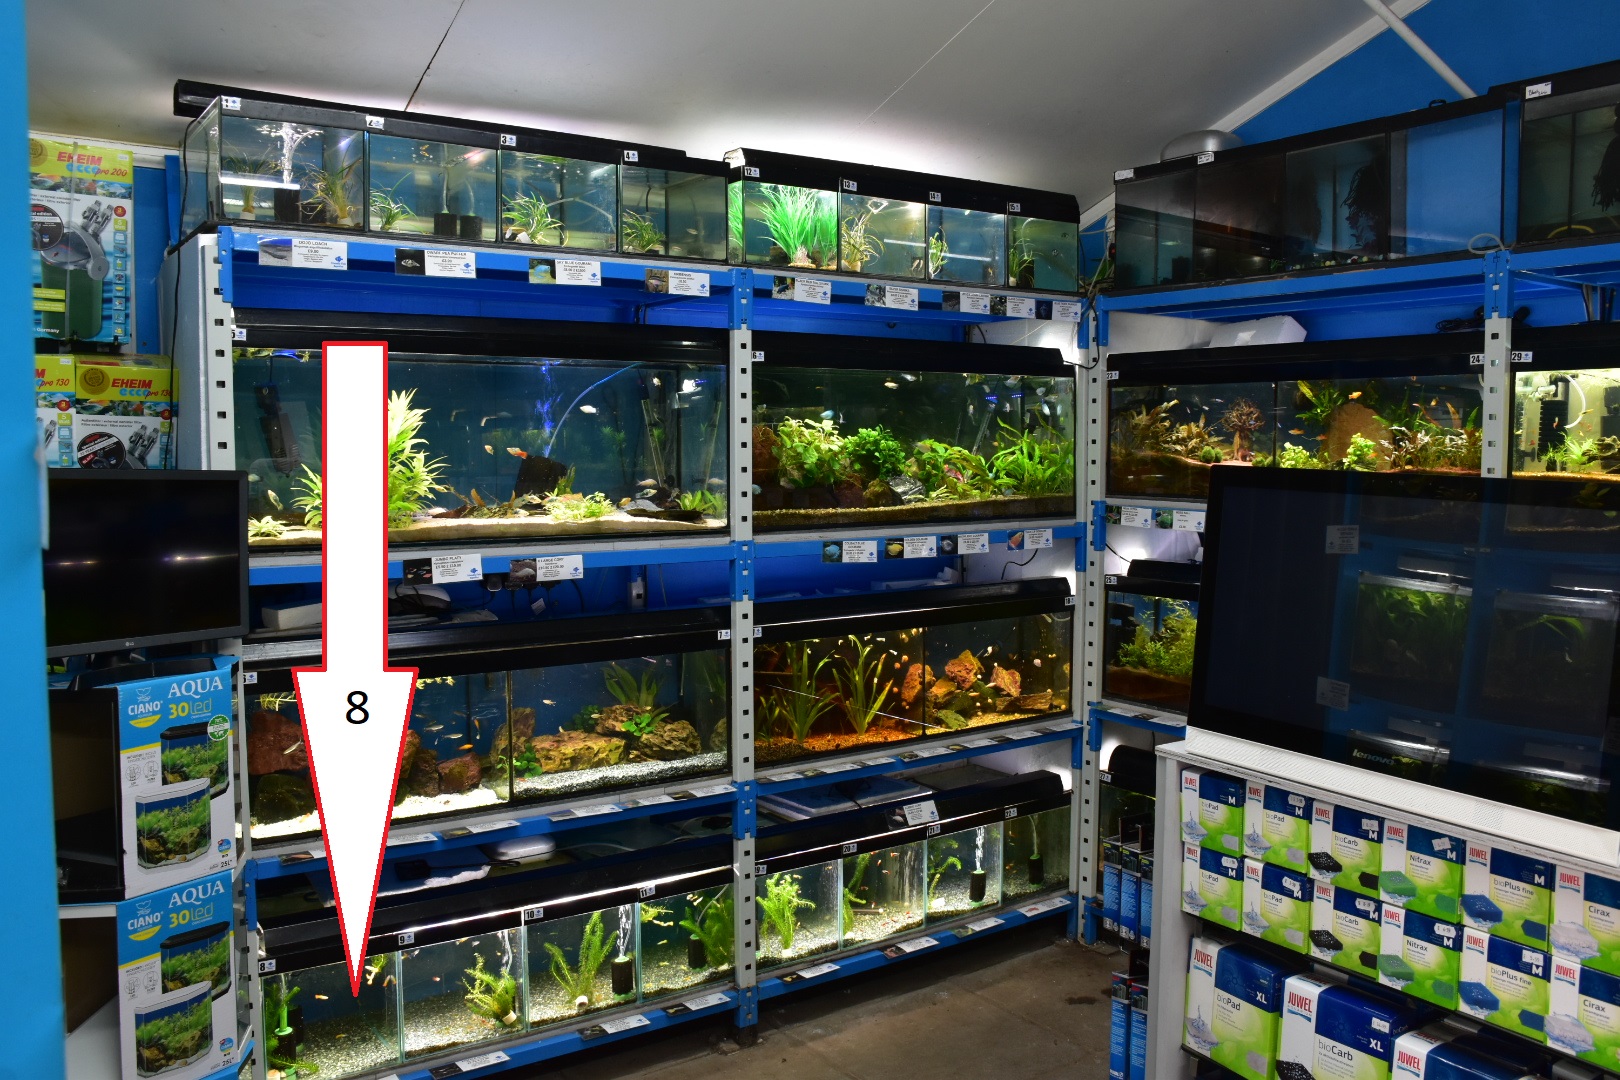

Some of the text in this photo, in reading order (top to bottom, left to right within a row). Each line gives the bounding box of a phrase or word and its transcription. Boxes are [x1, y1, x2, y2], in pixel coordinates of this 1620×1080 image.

[501, 136, 506, 144] 3
[57, 152, 102, 166] EHEIM
[625, 152, 630, 160] 4
[111, 168, 128, 177] 200
[1471, 355, 1480, 363] 24
[1512, 353, 1522, 361] 29
[111, 378, 152, 389] EHEIM
[168, 676, 223, 699] AQUA
[128, 702, 161, 716] CIANO
[1352, 749, 1394, 766] lenovo
[1184, 777, 1196, 787] JUWEL
[1248, 787, 1262, 797] JUWEL
[1202, 801, 1219, 811] bioPad
[1228, 795, 1235, 805] M
[1266, 812, 1285, 822] bioPad
[1295, 807, 1303, 816] M
[1315, 806, 1330, 819] JUWEL
[1369, 830, 1378, 840] M
[1387, 825, 1405, 838] JUWEL
[1334, 834, 1359, 847] bioCarb
[1186, 847, 1198, 858] JUWEL
[1447, 850, 1456, 861] M
[1469, 847, 1488, 860] JUWEL
[1410, 854, 1432, 866] Nitrax
[1202, 872, 1219, 882] bioPad
[1229, 868, 1236, 878] M
[1246, 866, 1259, 877] JUWEL
[1534, 874, 1545, 886] M
[1559, 872, 1580, 887] JUWEL
[641, 889, 646, 897] 11
[1316, 885, 1332, 898] JUWEL
[1493, 878, 1535, 896] bioPlus fine
[168, 881, 224, 908] AQUA
[1264, 892, 1282, 903] bioPad
[1294, 890, 1302, 899] M
[526, 910, 534, 919] 10
[1370, 911, 1378, 921] M
[1384, 909, 1401, 922] JUWEL
[1589, 905, 1610, 918] Cirax
[128, 912, 161, 930] CIANO
[1335, 913, 1359, 926] bioCarb
[400, 936, 404, 944] 9
[1407, 940, 1428, 952] Nitrax
[1444, 937, 1453, 948] M
[1466, 935, 1485, 949] JUWEL
[1194, 949, 1213, 968] JUWEL
[260, 963, 265, 971] 8
[1532, 965, 1543, 977] M
[1555, 964, 1576, 980] JUWEL
[1491, 967, 1532, 986] bioPlus fine
[1217, 993, 1241, 1011] bioPad
[1256, 991, 1267, 1004] XL
[1288, 991, 1312, 1013] JUWEL
[1583, 999, 1606, 1013] Cirax
[1318, 1039, 1353, 1061] bioCarb
[1370, 1038, 1384, 1052] XL
[1397, 1050, 1421, 1070] JUWEL
